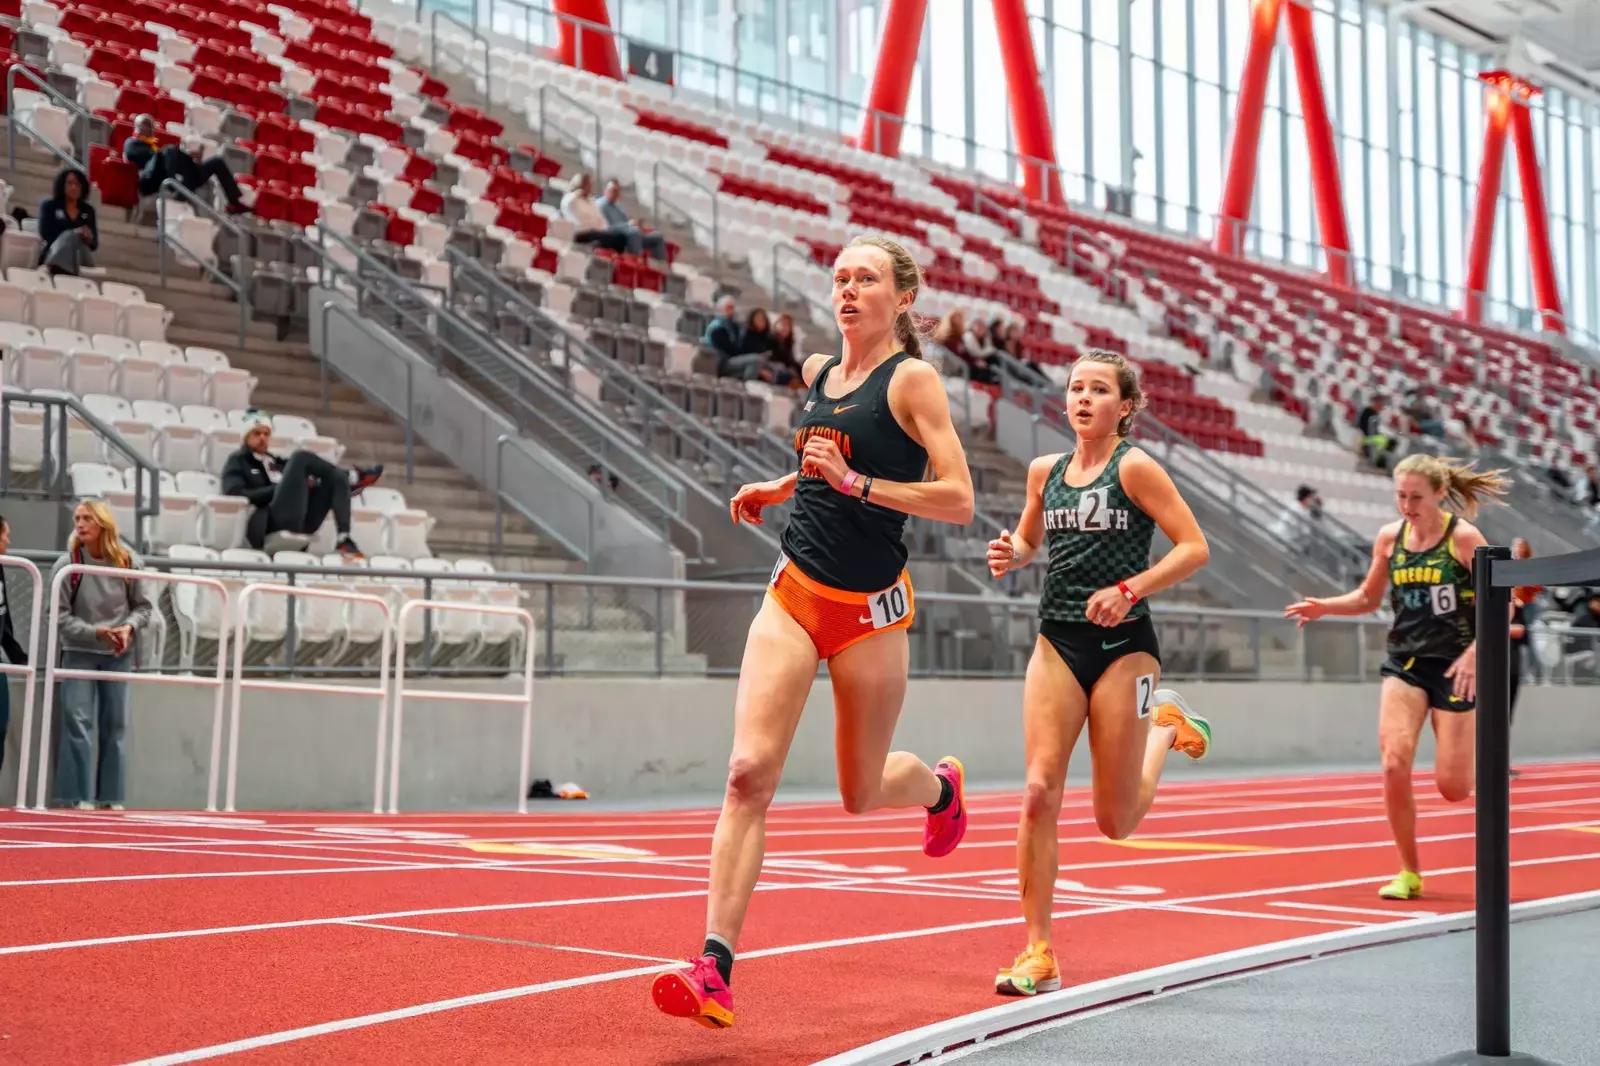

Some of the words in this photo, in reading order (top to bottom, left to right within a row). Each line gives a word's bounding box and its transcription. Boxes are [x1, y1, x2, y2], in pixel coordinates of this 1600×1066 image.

[1084, 491, 1101, 528] 2
[876, 586, 905, 624] 10
[1437, 586, 1451, 611] 6
[1141, 677, 1150, 716] 2
